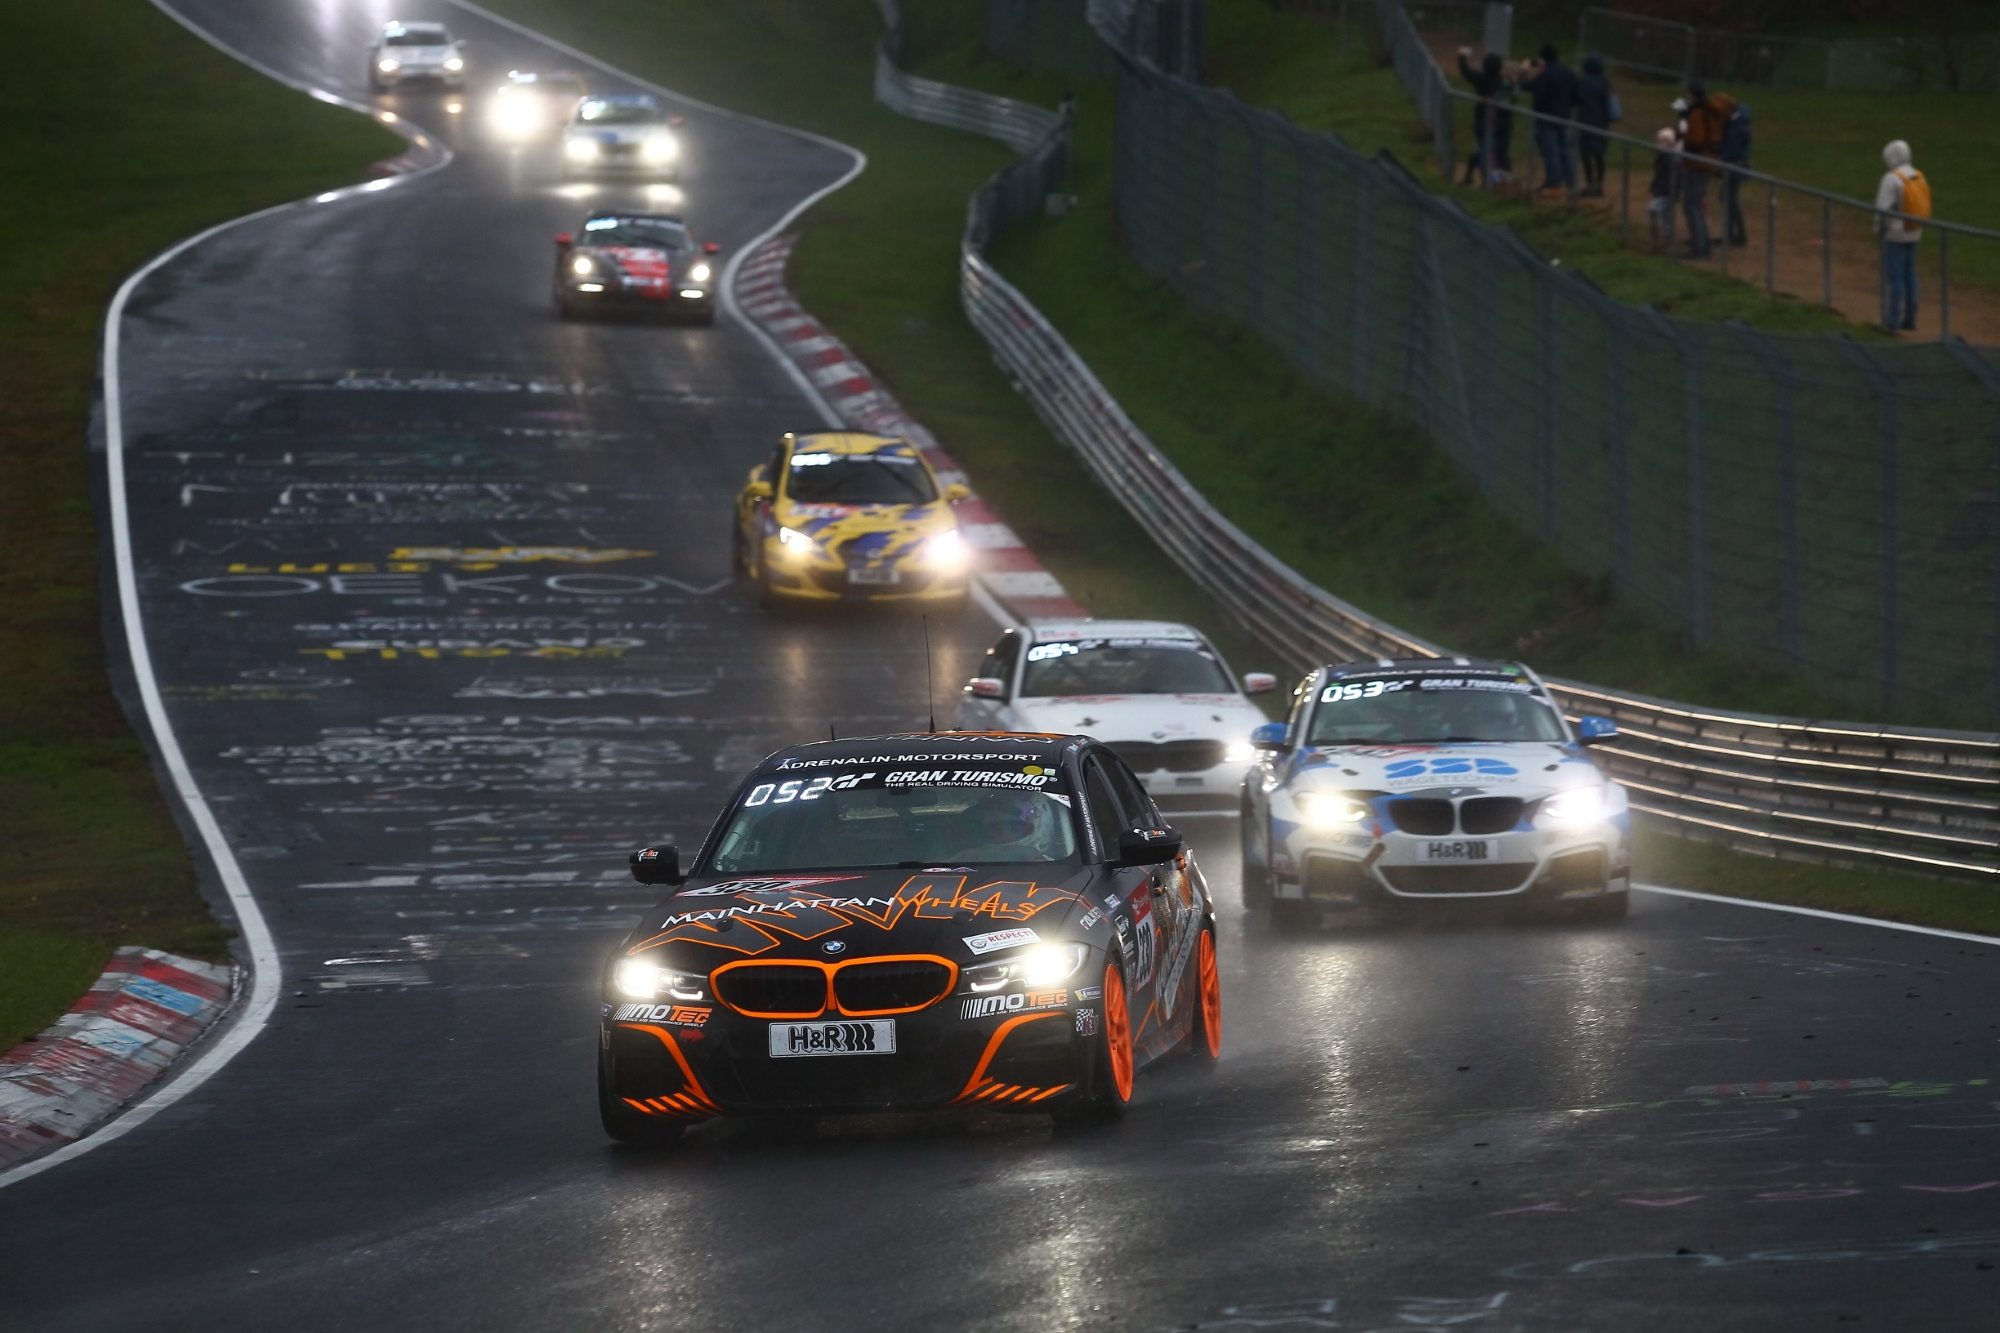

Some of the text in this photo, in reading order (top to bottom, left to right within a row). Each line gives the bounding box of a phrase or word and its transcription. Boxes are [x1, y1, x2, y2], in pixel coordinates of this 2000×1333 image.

[1320, 680, 1385, 703] 053
[1420, 679, 1462, 688] GRAN
[885, 771, 948, 783] GRAN
[982, 782, 1042, 792] SIMULATOR
[744, 776, 833, 807] 052
[661, 896, 895, 929] MAINHATTAN
[788, 1025, 847, 1053] H&R
